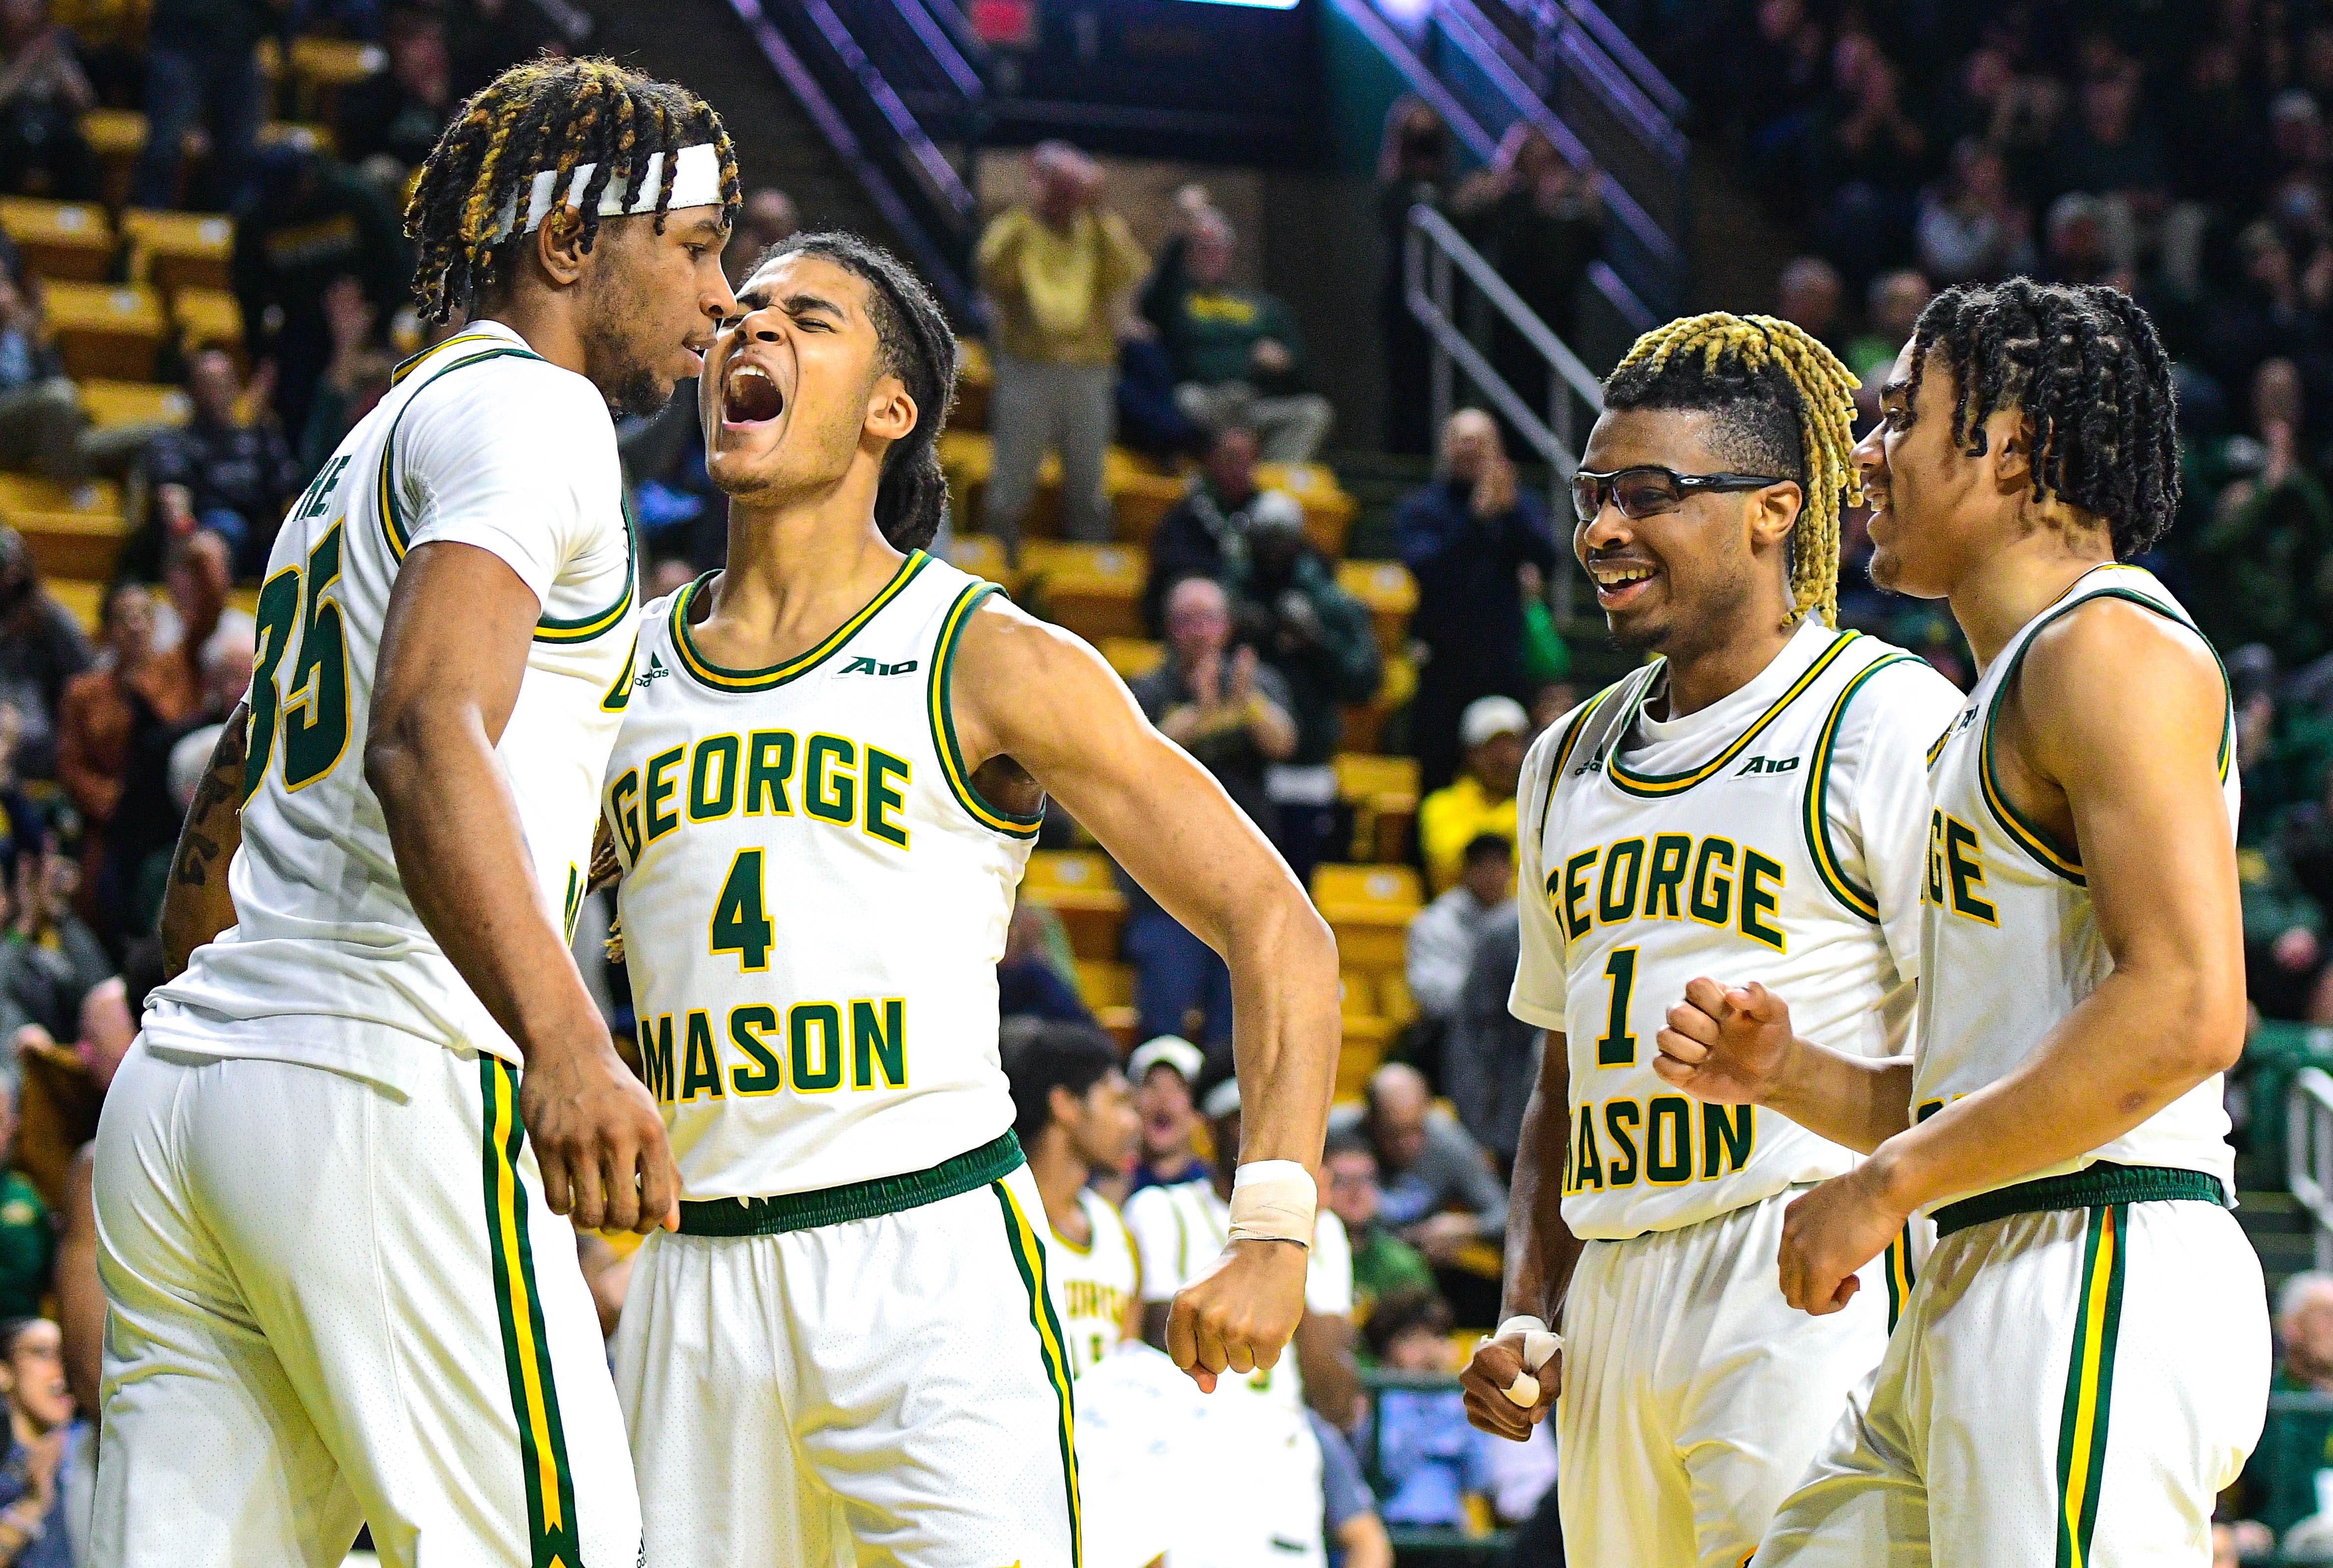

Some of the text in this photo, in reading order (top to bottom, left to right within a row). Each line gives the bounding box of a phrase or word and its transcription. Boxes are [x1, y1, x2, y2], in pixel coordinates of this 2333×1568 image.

[241, 516, 352, 813] 35
[837, 656, 918, 676] A10
[612, 729, 912, 870] GEORGE
[1734, 756, 1799, 777] A10
[709, 846, 775, 973] 4
[641, 997, 908, 1106] MASON
[1596, 945, 1639, 1068] 1
[1561, 1094, 1756, 1198] ASON
